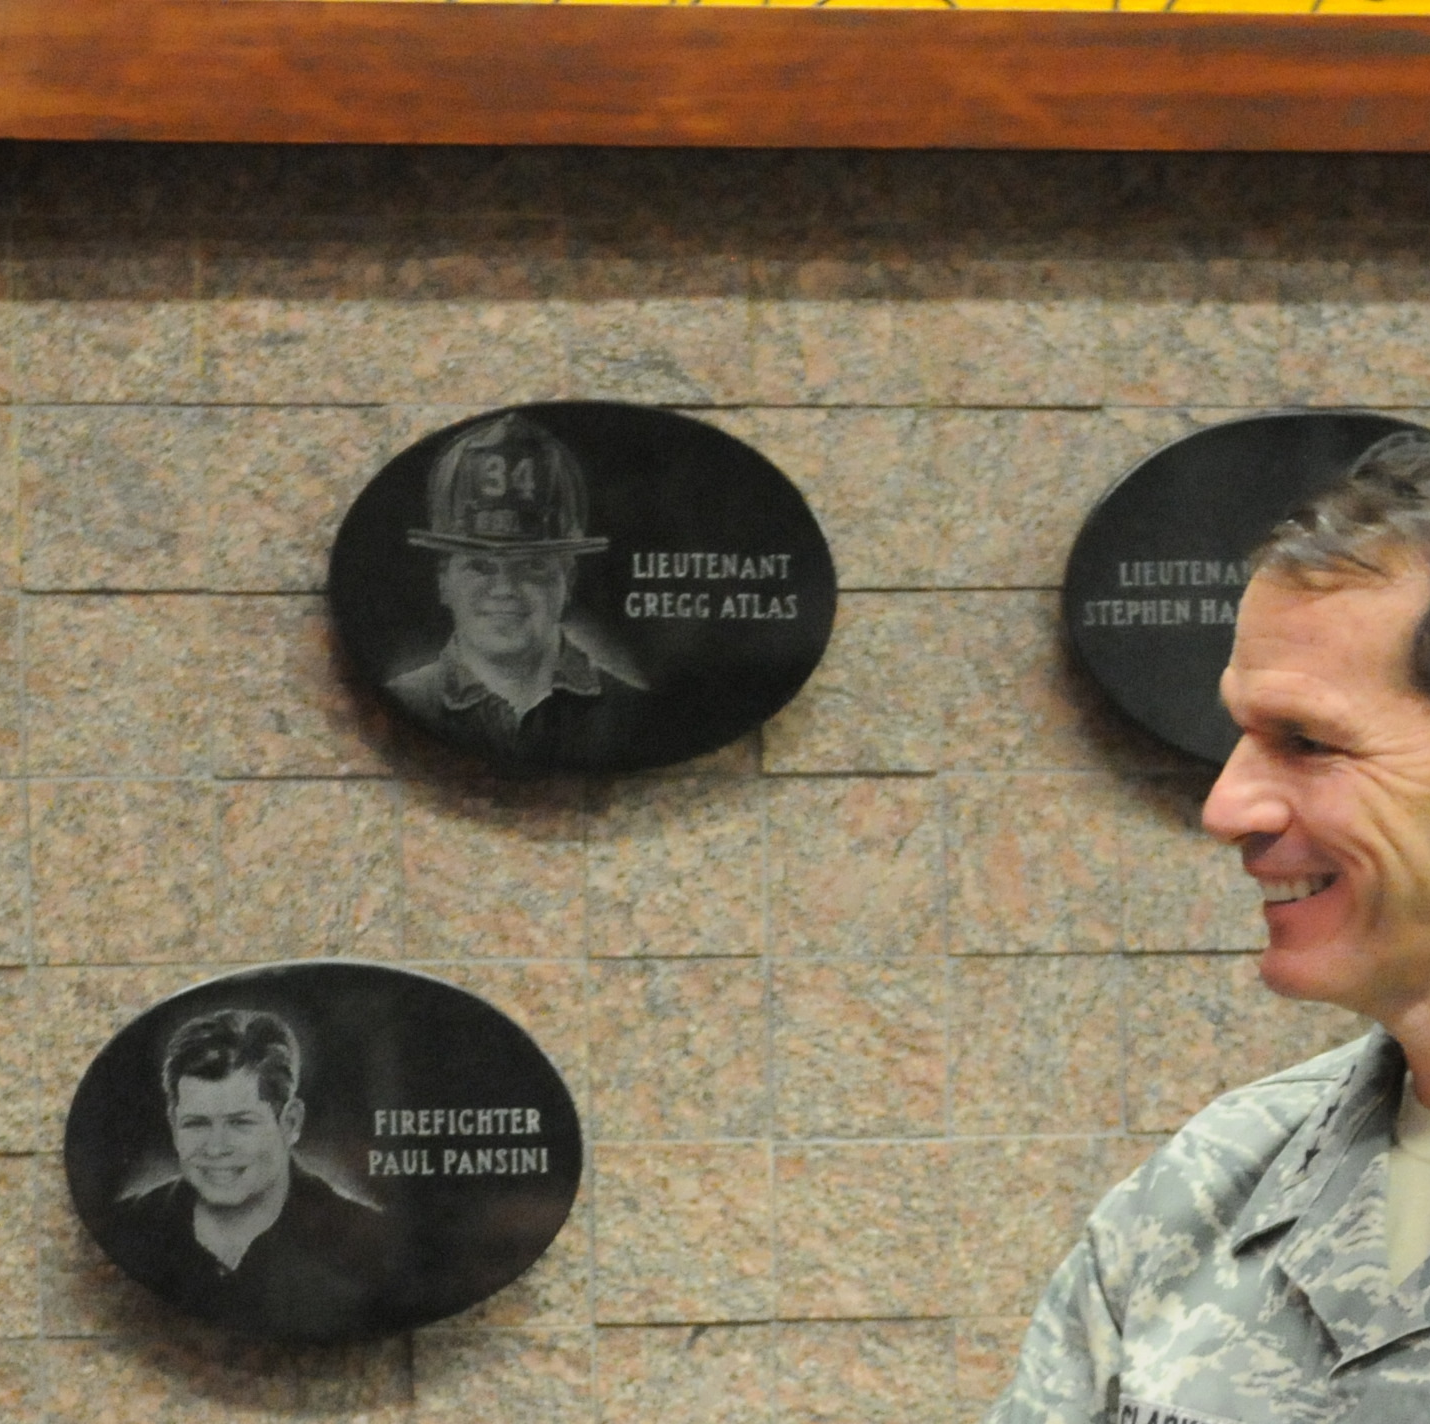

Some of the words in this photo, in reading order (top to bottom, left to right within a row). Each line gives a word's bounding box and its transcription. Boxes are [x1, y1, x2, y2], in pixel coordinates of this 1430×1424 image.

[631, 551, 792, 580] LIEUTENANT
[624, 591, 711, 620] GREGG
[719, 593, 799, 620] ATLAS
[1082, 599, 1192, 627] STEPHEN
[373, 1106, 542, 1137] FIREFIGHTER
[367, 1147, 435, 1177] PAUL
[442, 1146, 550, 1176] PANSINI
